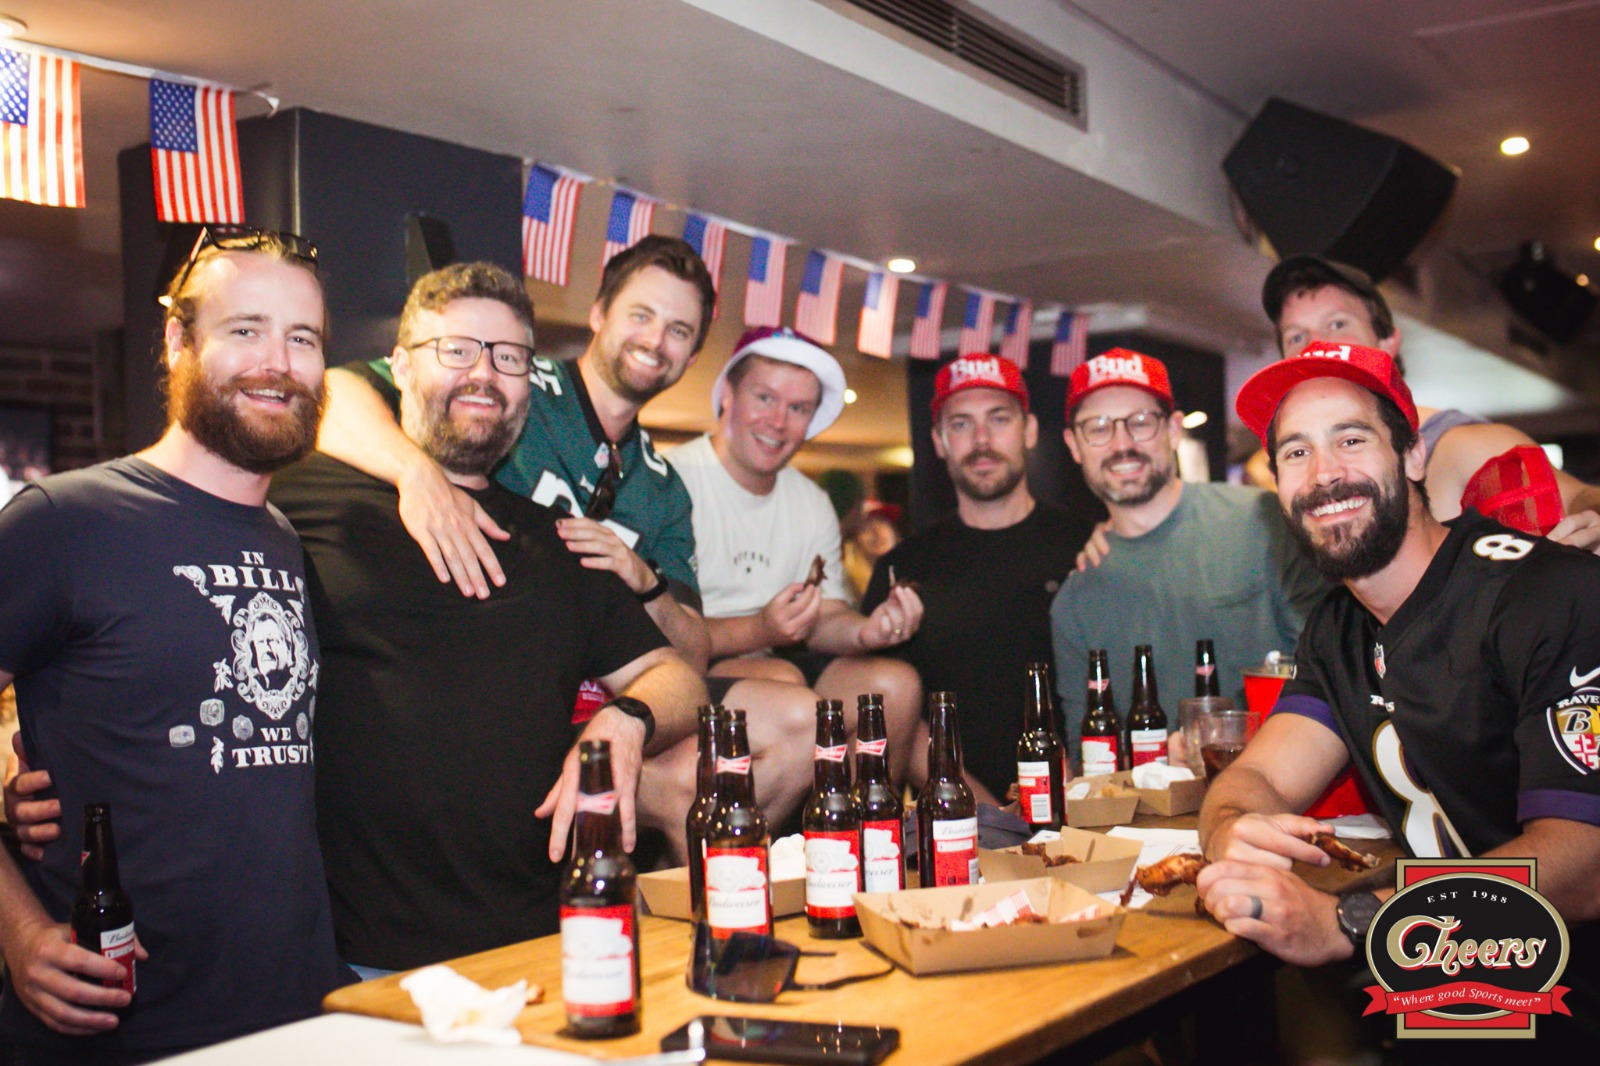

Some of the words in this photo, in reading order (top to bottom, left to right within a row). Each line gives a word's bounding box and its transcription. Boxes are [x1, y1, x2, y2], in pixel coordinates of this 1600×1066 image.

[950, 357, 1000, 379] Bud
[1087, 354, 1144, 377] Bud
[241, 550, 265, 566] IN
[1472, 534, 1535, 561] 8
[260, 727, 292, 742] WE
[231, 745, 309, 768] TRUST
